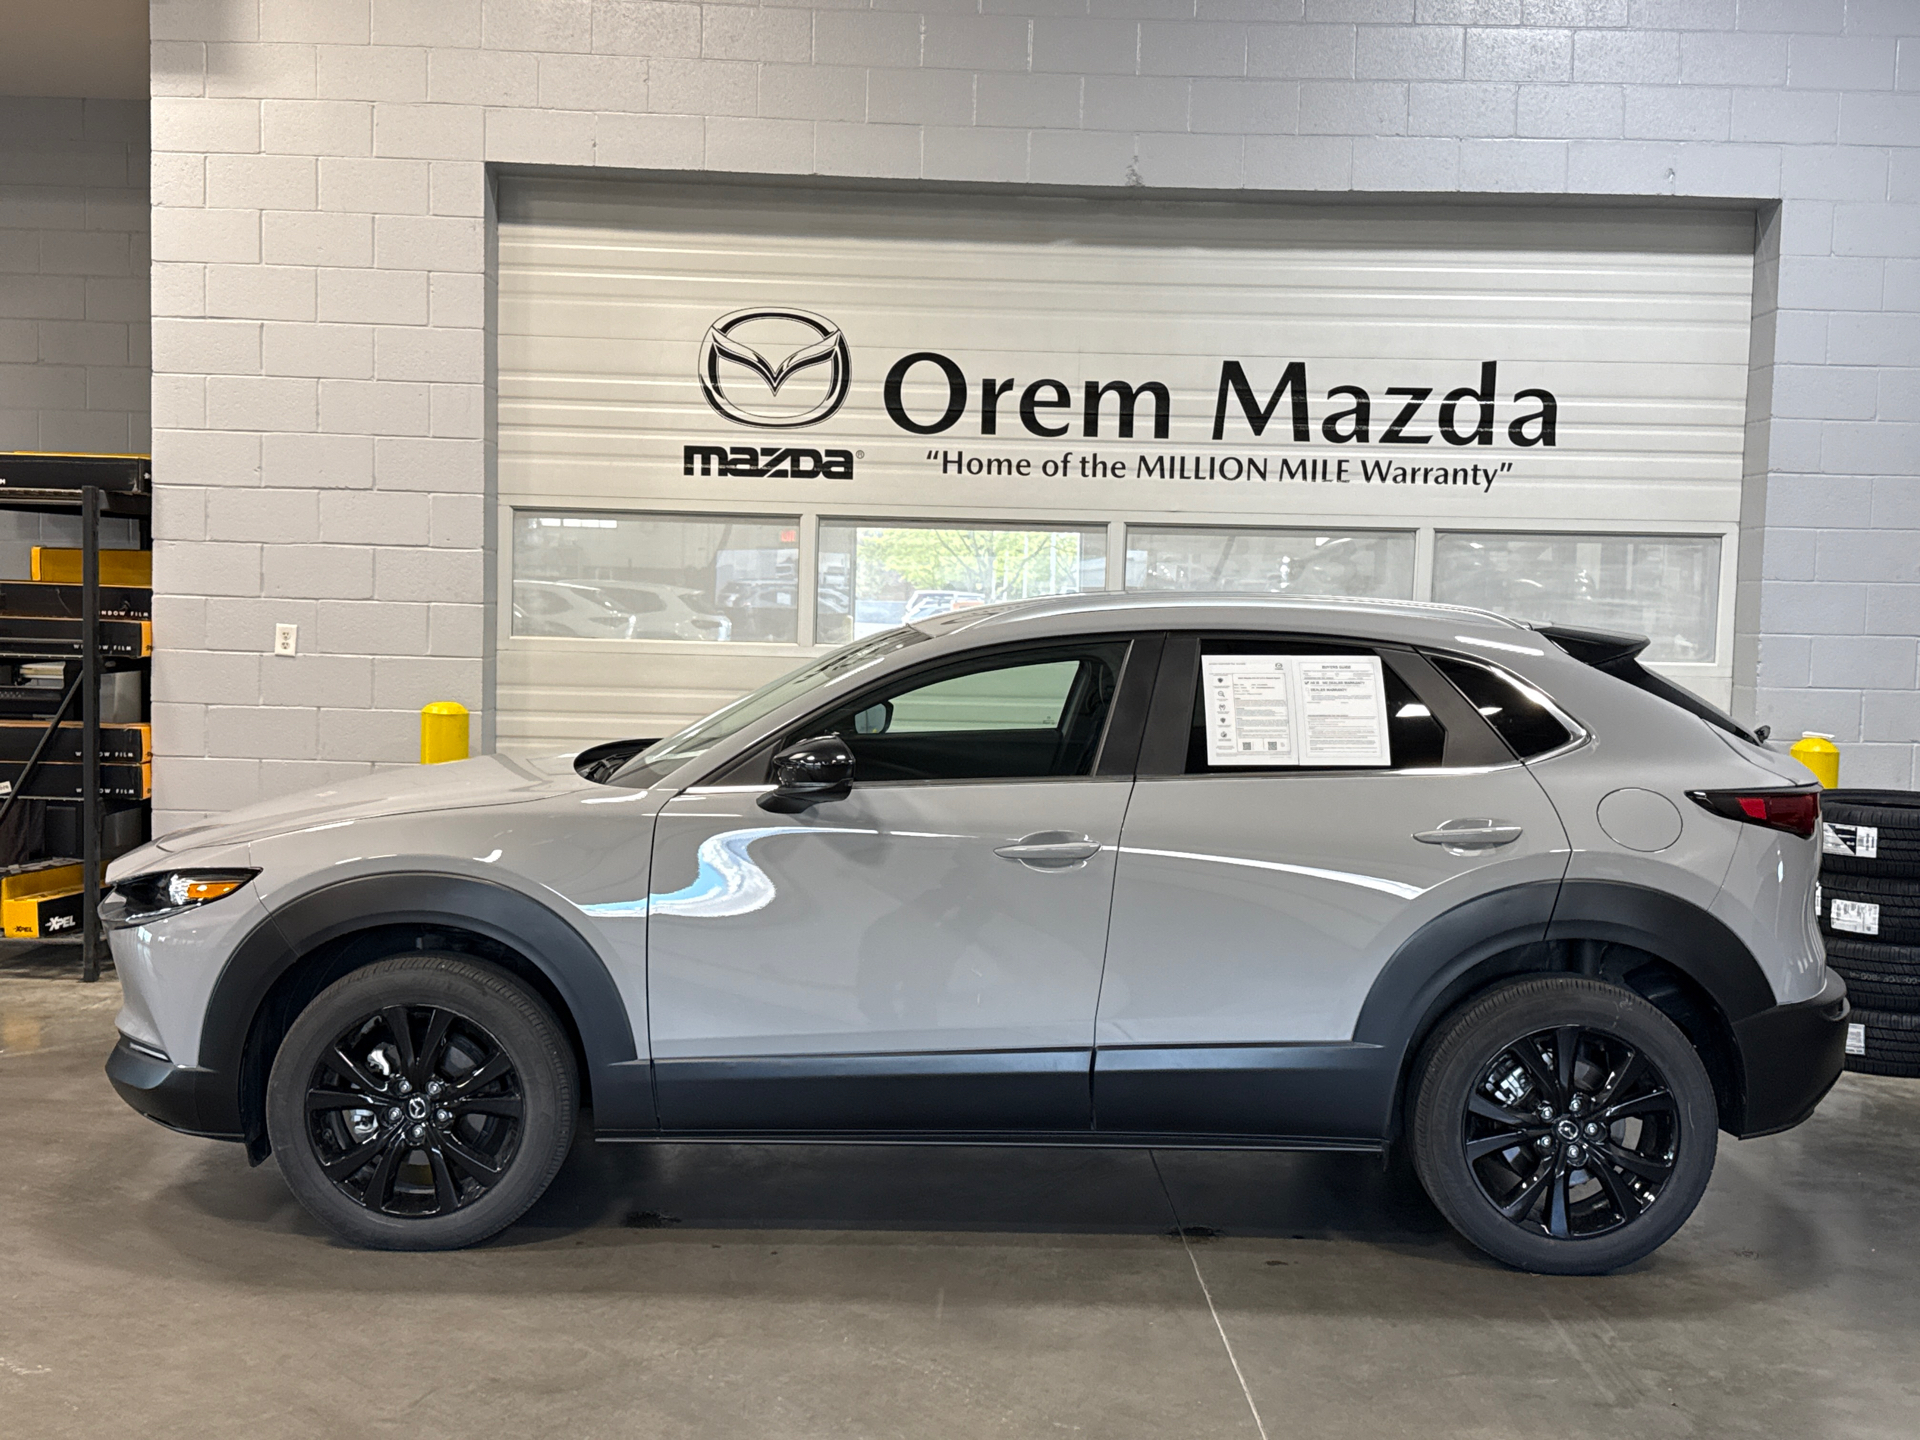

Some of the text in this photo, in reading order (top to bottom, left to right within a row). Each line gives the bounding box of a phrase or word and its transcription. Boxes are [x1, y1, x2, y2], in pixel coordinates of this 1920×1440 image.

[883, 351, 1558, 447] Orem Mazda
[683, 445, 854, 480] mazda
[1041, 452, 1073, 478] of
[1079, 452, 1126, 479] the
[1136, 455, 1268, 482] MILLION
[1279, 458, 1350, 483] MILE
[45, 915, 76, 932] XPEL
